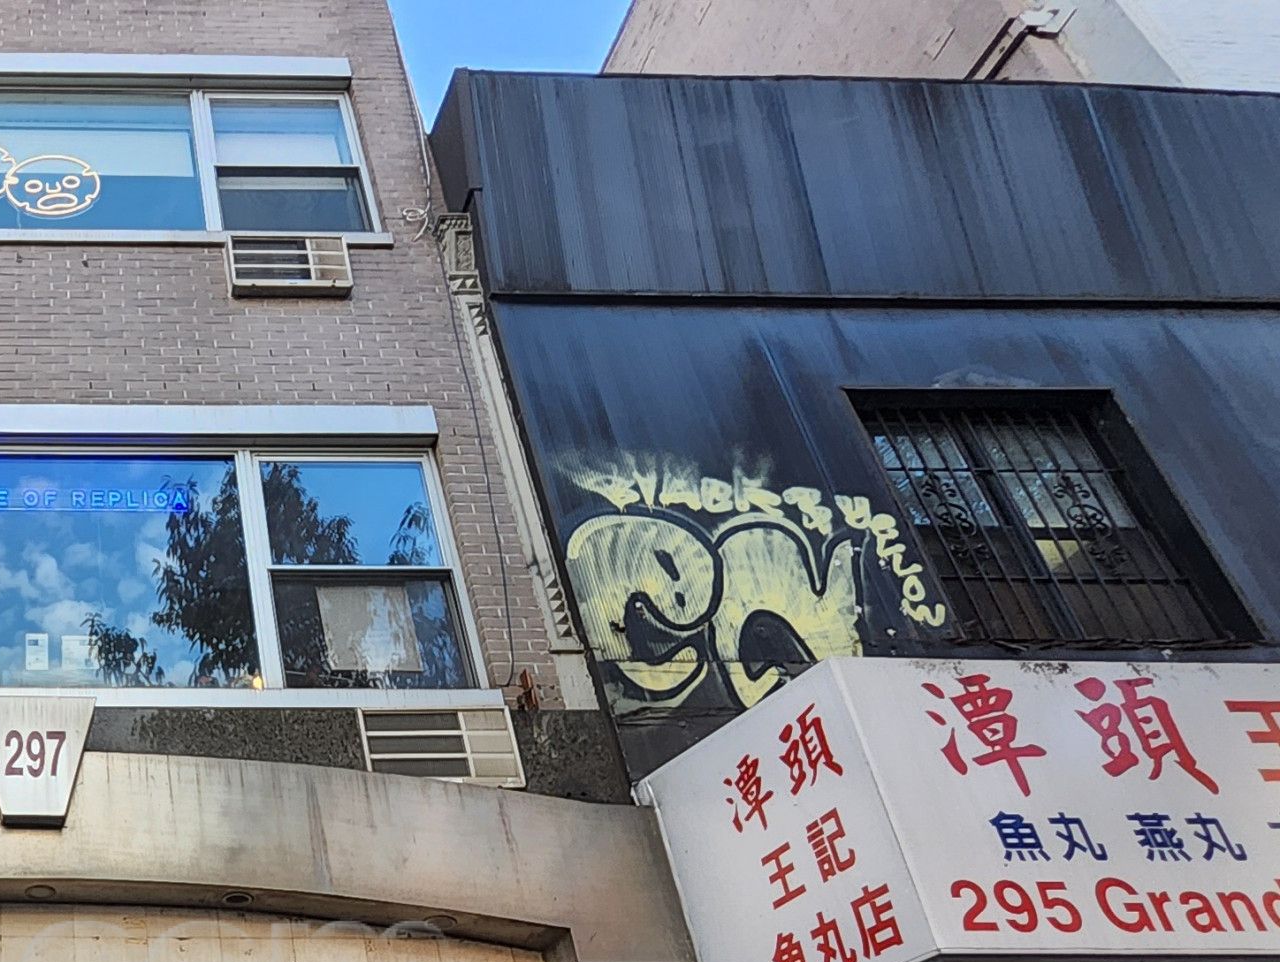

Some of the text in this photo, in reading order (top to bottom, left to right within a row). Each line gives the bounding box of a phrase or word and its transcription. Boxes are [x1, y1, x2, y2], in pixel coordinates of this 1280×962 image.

[23, 489, 57, 507] OF
[72, 489, 189, 508] REPLICA
[4, 729, 67, 778] 297
[723, 703, 845, 834] 潭頭
[761, 807, 857, 911] 王記
[989, 810, 1248, 862] 魚丸 燕丸
[950, 879, 1083, 934] 295
